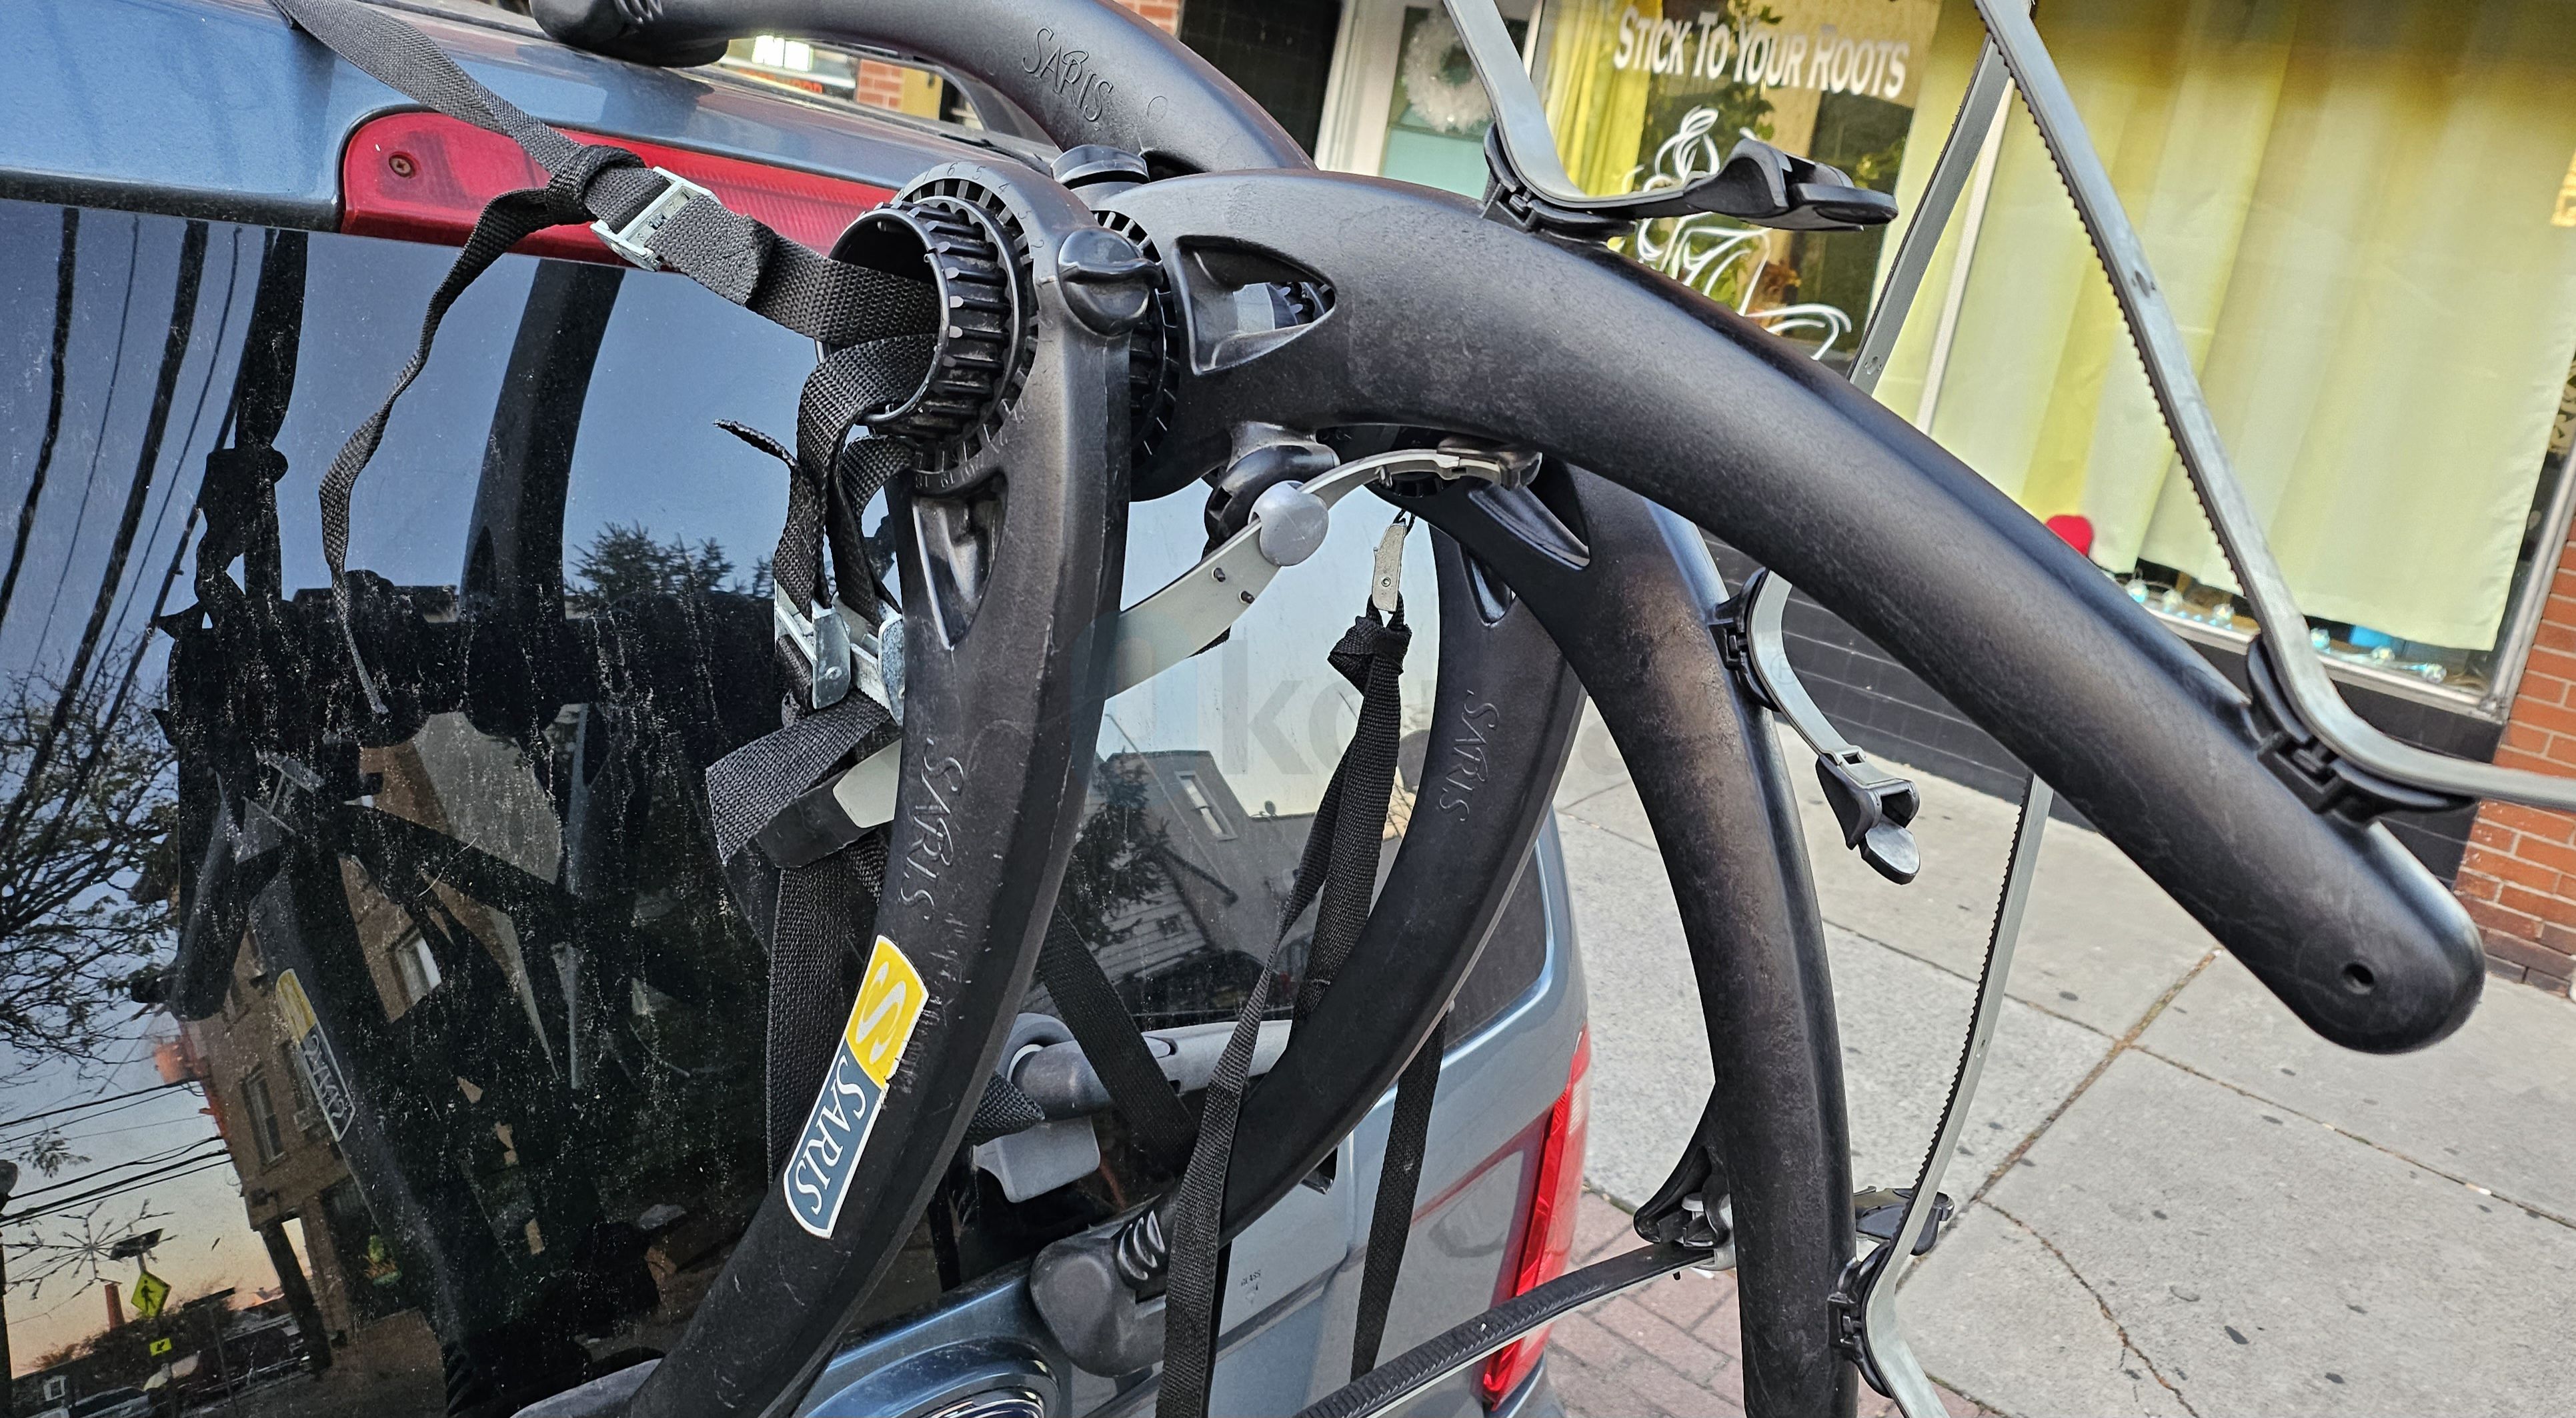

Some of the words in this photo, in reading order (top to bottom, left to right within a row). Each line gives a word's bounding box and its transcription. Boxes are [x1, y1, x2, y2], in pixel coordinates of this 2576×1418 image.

[1022, 27, 1114, 122] SARIS
[1806, 24, 1909, 99] ROOTS
[1439, 689, 1500, 822] SARIS
[900, 737, 964, 920] SARIS
[795, 1054, 868, 1216] SARIS
